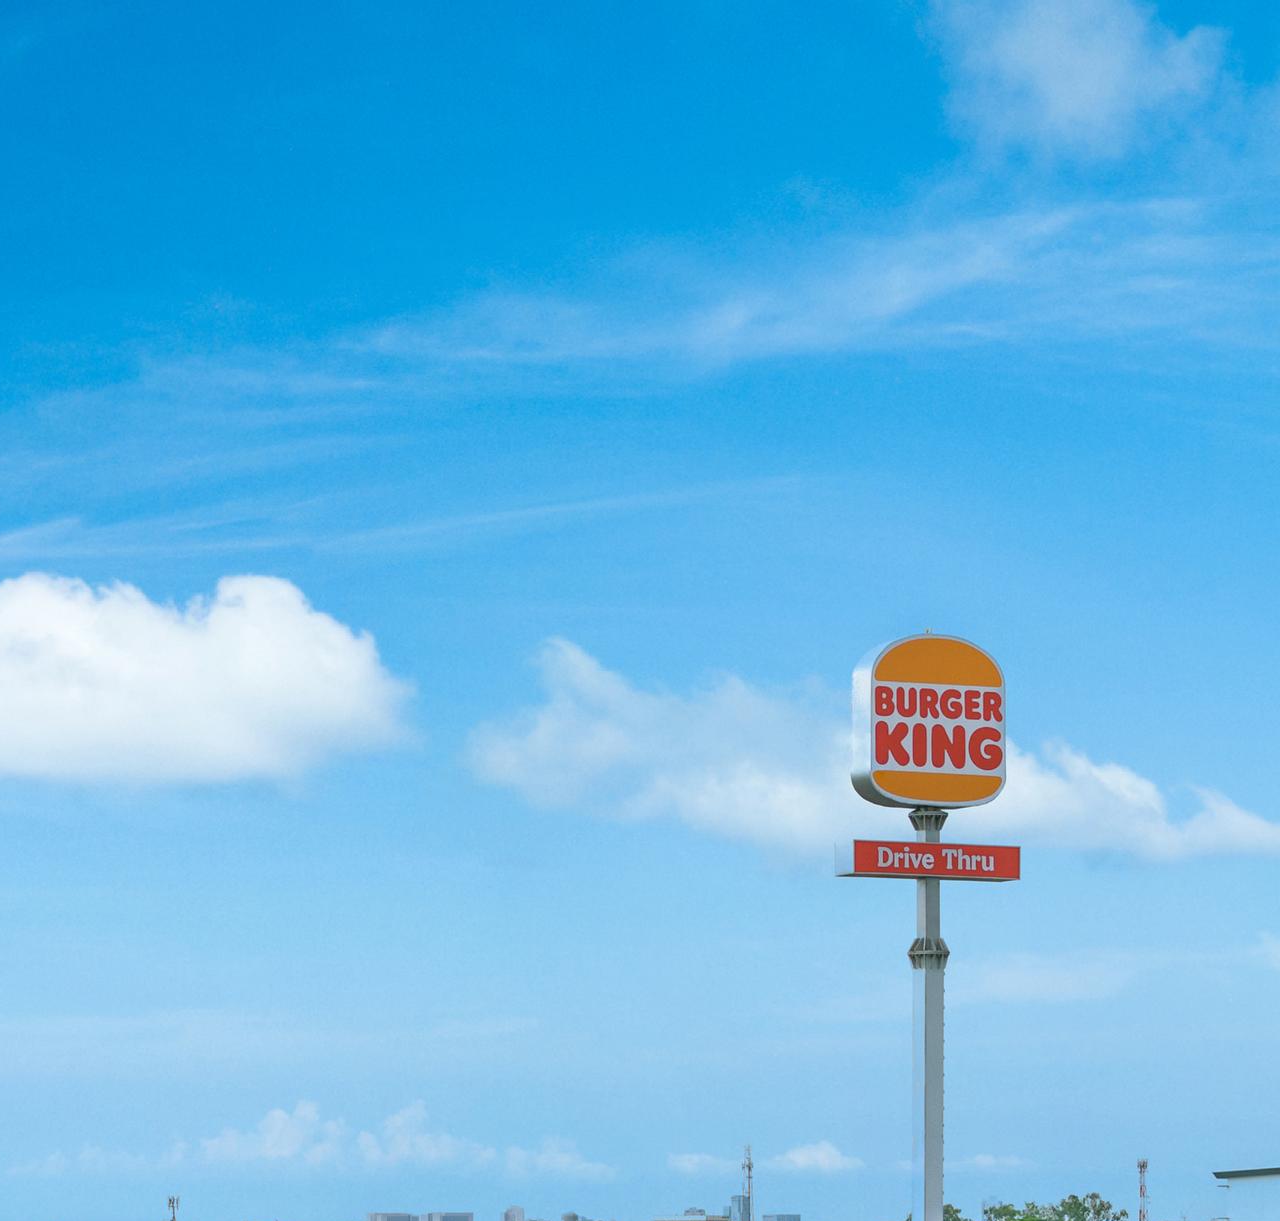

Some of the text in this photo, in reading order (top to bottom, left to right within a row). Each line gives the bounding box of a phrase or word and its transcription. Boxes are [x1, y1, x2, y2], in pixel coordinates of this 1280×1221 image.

[874, 684, 1003, 723] BURGER
[874, 720, 1003, 771] KING
[877, 845, 995, 872] Drive Thru
